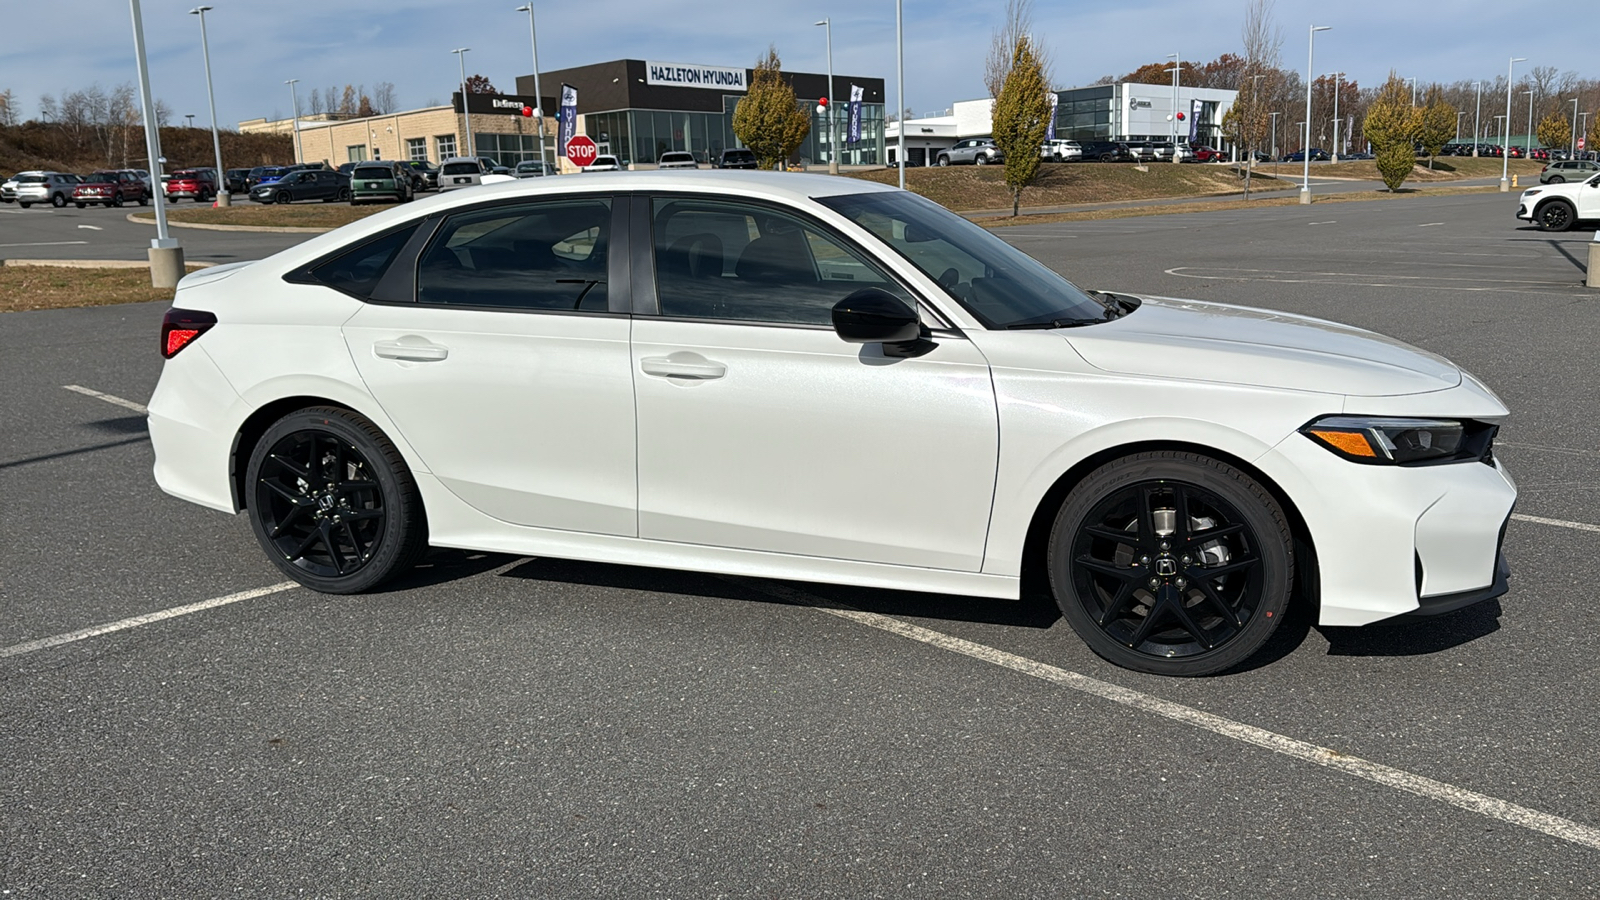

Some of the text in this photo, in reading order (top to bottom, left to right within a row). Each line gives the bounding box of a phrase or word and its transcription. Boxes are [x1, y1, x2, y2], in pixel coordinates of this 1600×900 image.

[651, 66, 742, 86] HAZLETON HYUNDAI
[568, 145, 595, 158] STOP
[1094, 471, 1133, 495] SPORT
[372, 503, 396, 571] GOODYEAR
